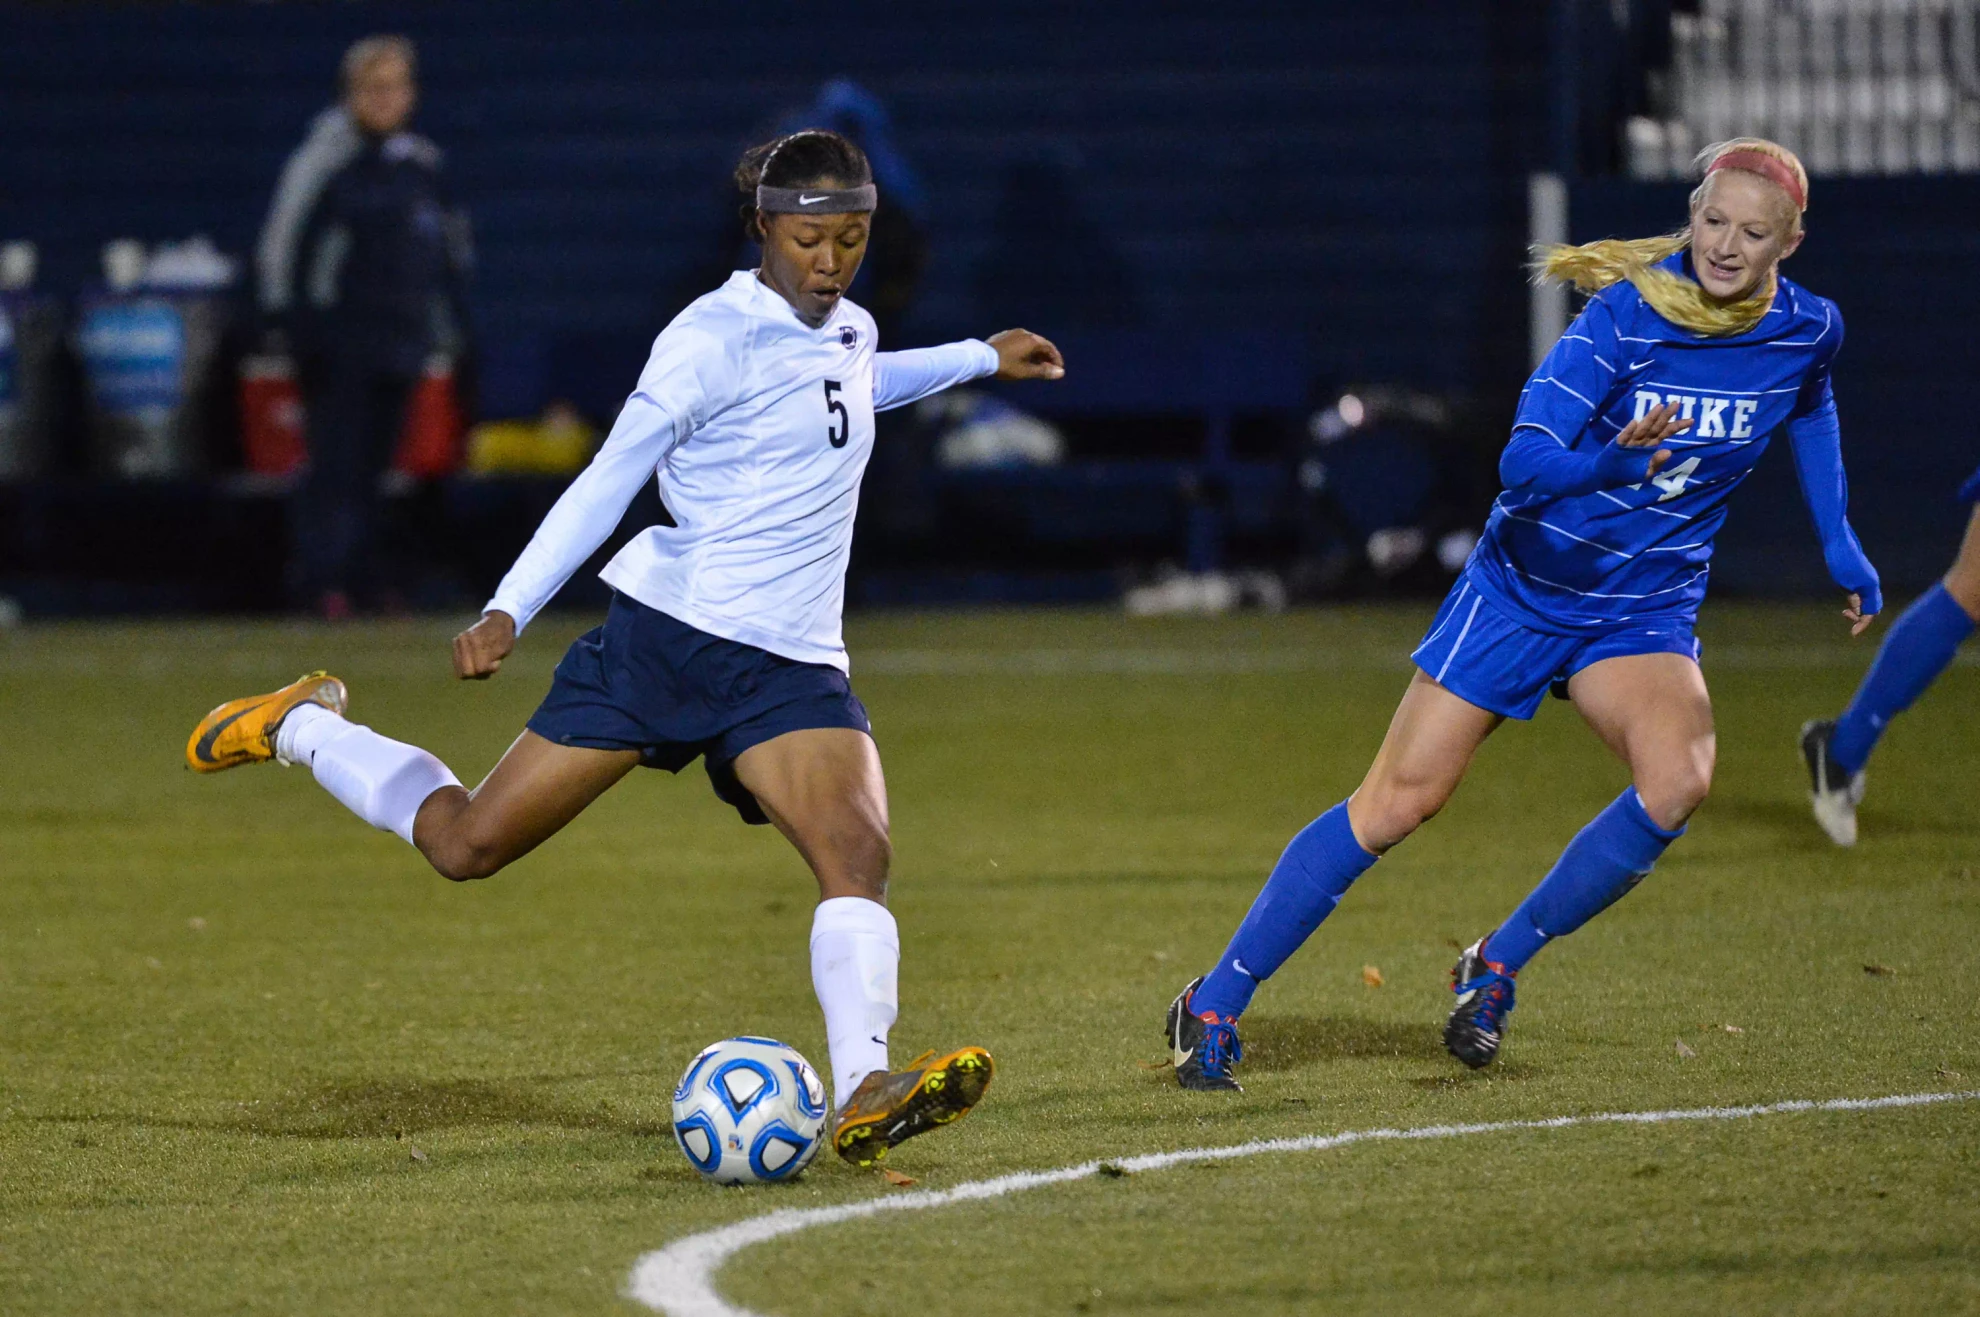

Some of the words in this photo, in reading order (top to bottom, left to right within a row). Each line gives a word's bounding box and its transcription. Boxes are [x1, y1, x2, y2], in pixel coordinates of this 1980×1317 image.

[824, 379, 849, 448] 5
[1634, 390, 1758, 439] DUKE
[1627, 456, 1702, 502] 4
